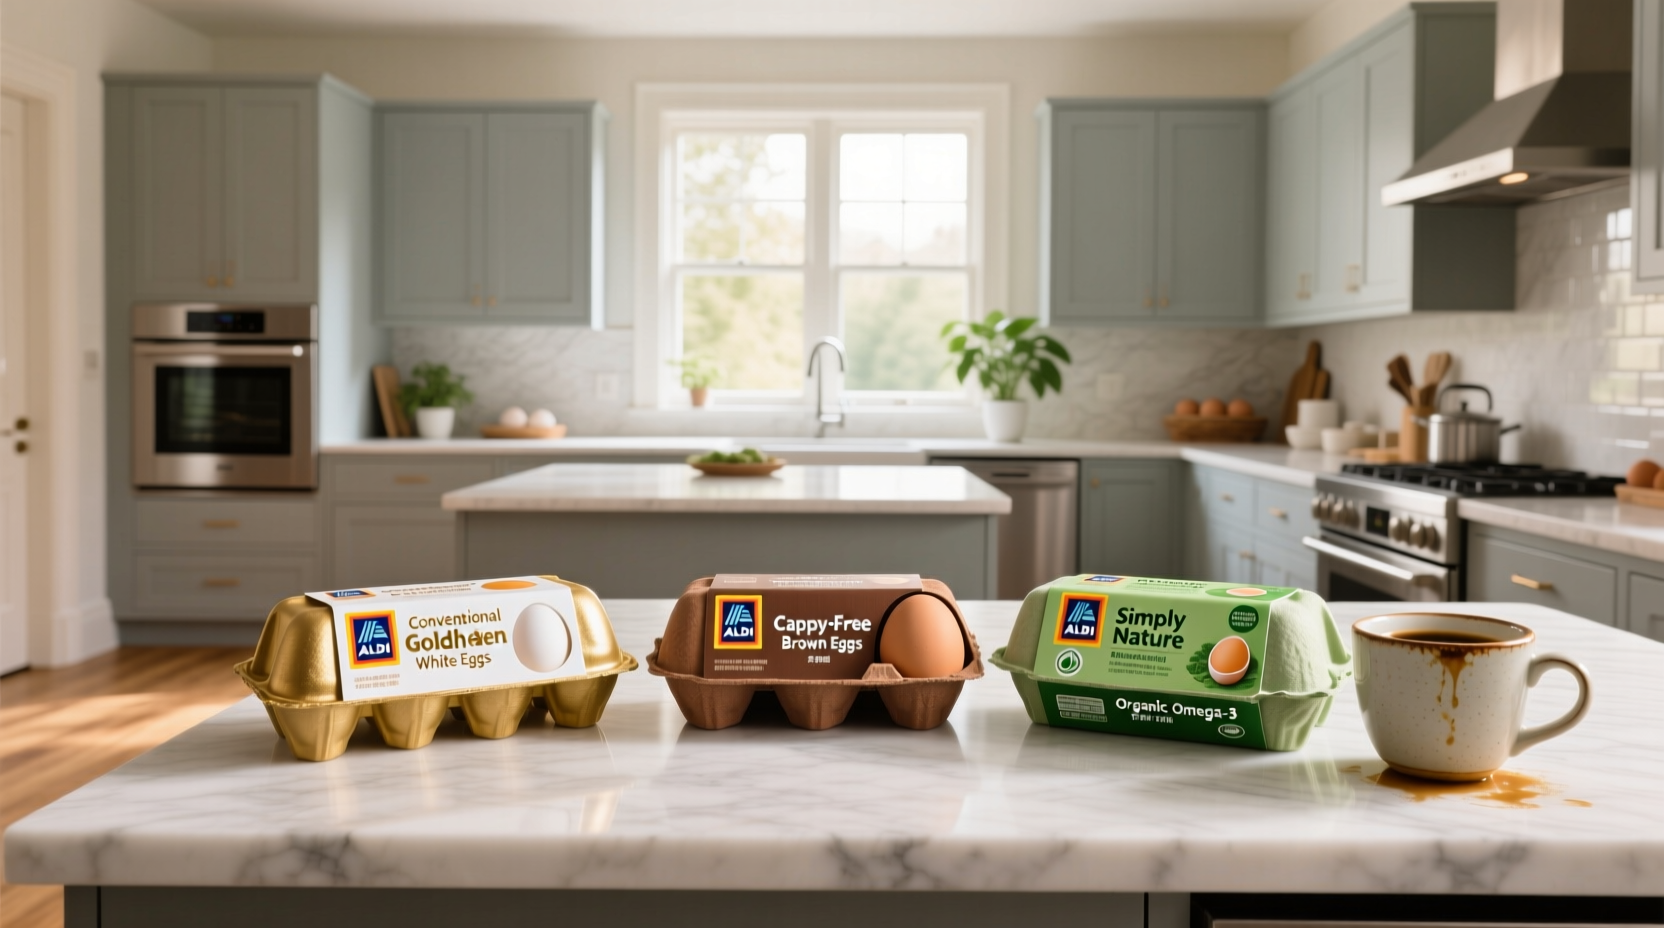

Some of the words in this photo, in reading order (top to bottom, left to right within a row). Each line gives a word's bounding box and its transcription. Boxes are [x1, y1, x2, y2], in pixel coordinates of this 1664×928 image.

[408, 607, 502, 630] Conventional
[773, 614, 872, 635] Cappy-Free
[1115, 606, 1187, 633] Simply
[723, 625, 754, 637] ALDI
[1064, 623, 1095, 636] ALDI
[1112, 626, 1185, 649] Nature
[358, 642, 391, 657] ALDI
[781, 635, 827, 650] Brown
[830, 637, 863, 654] Eggs
[415, 654, 458, 670] White
[460, 652, 492, 669] Eggs
[1115, 698, 1168, 713] Organic
[1172, 702, 1238, 721] Omega-3
